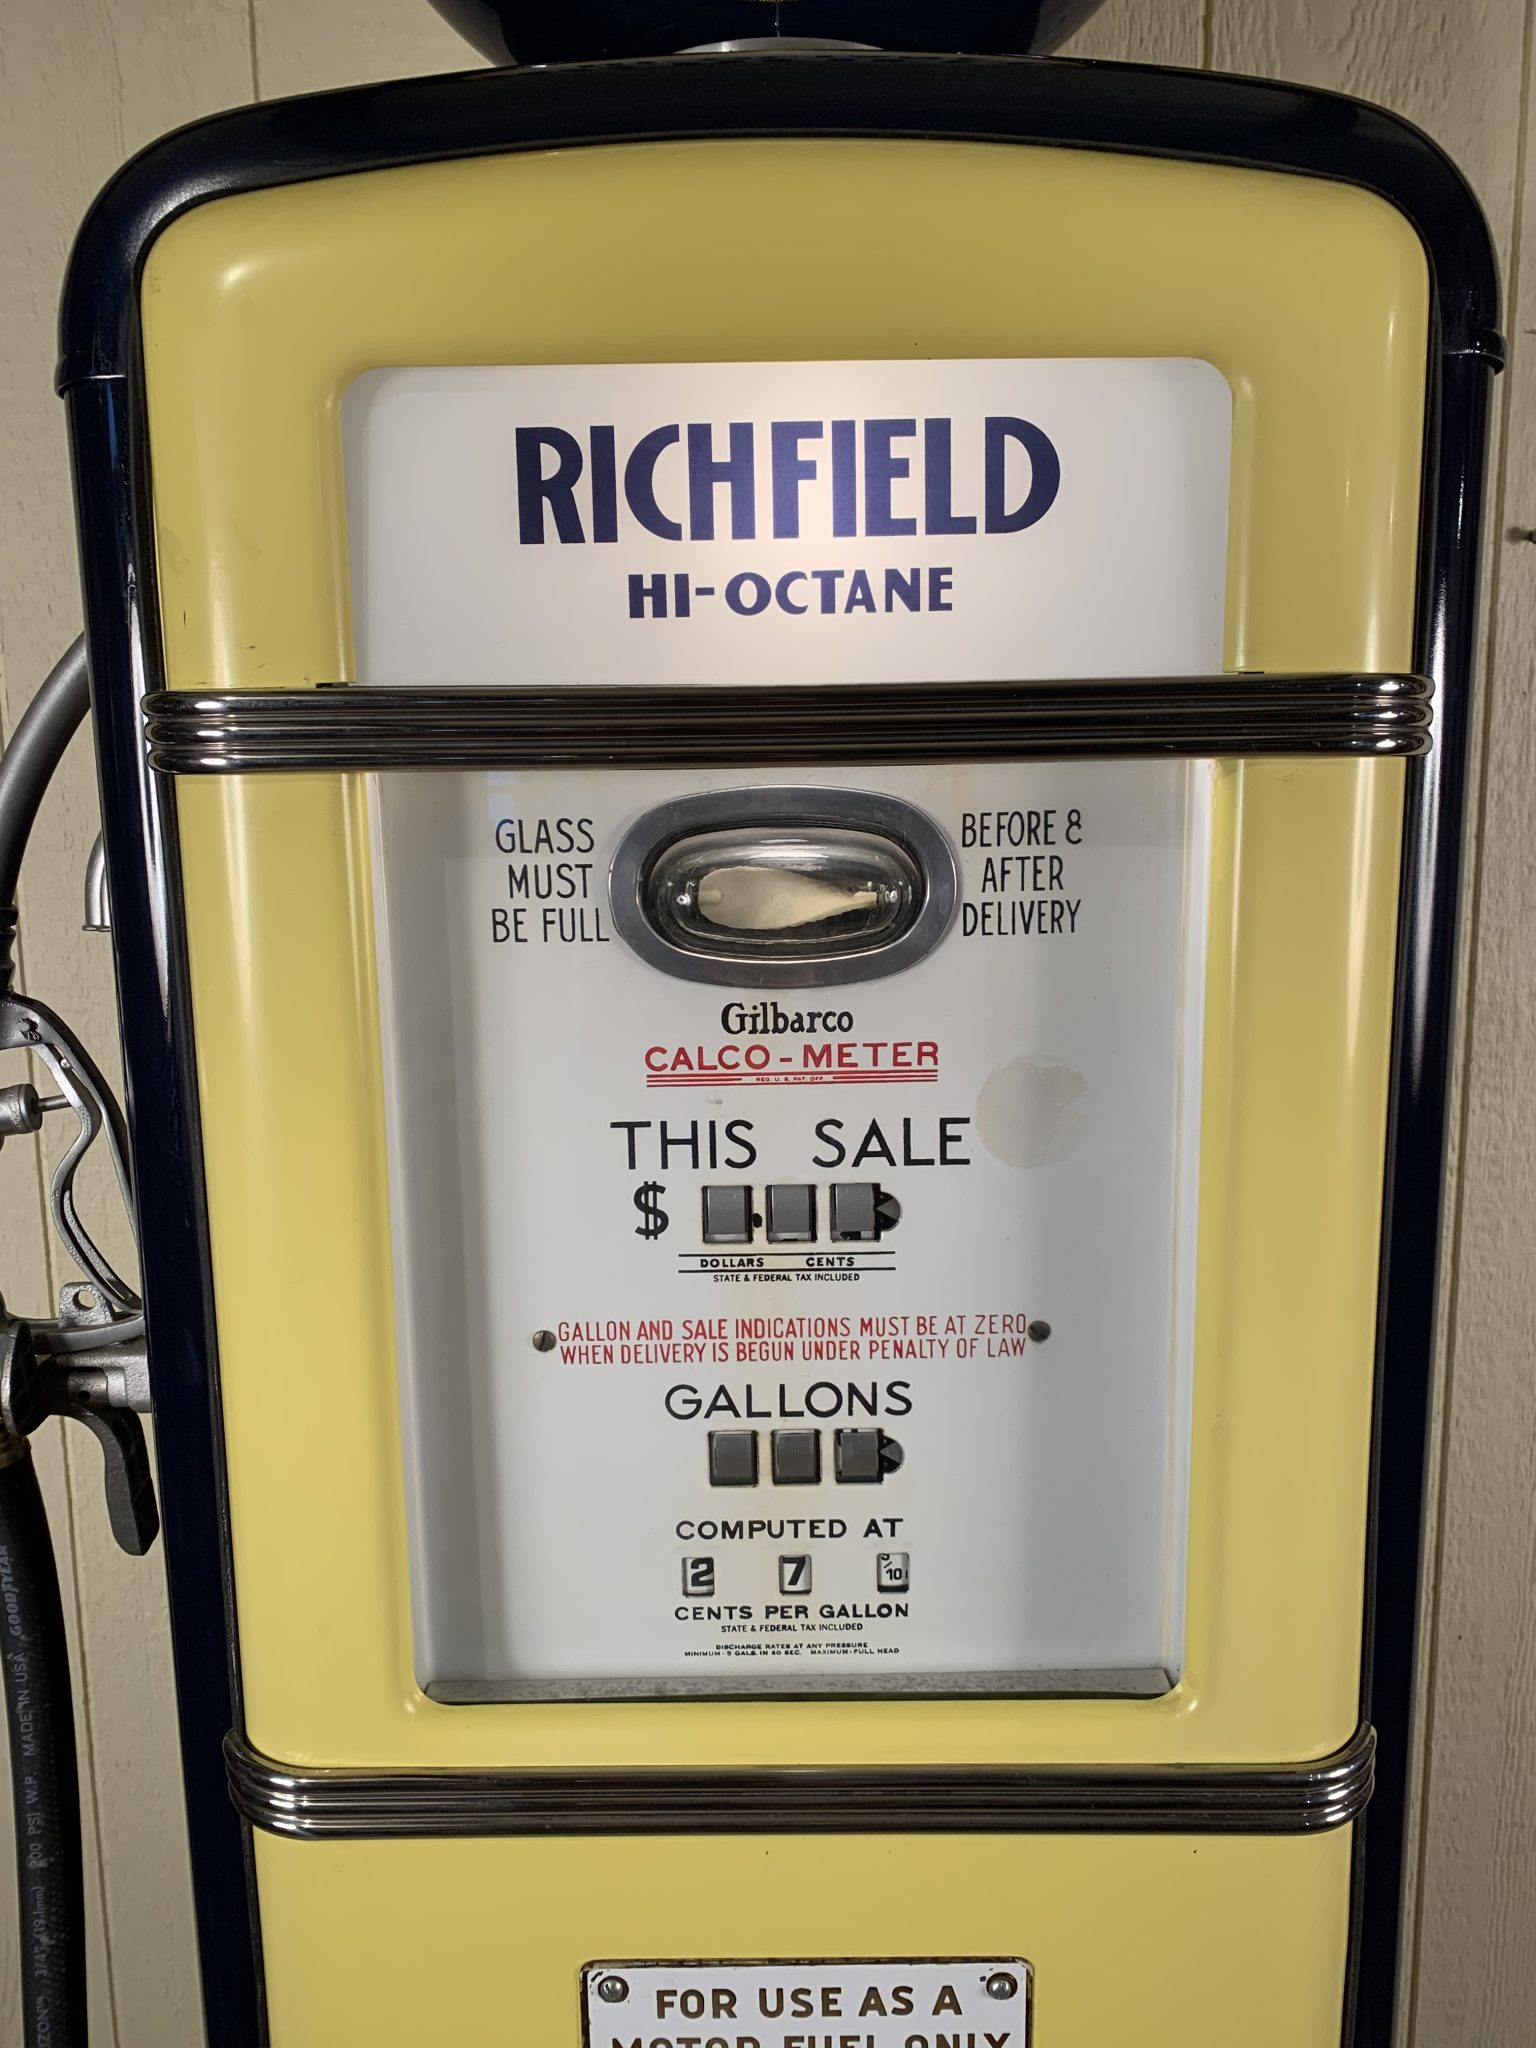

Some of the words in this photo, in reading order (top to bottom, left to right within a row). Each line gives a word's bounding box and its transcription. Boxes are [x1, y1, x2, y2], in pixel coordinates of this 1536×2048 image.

[515, 416, 1061, 545] RICHFIELD
[628, 567, 953, 619] HI-OCTANE
[495, 818, 595, 854] GLASS
[962, 809, 1057, 848] BEFORE
[508, 863, 593, 899] MUST
[981, 855, 1064, 893] AFTER
[491, 908, 528, 943] BE
[542, 907, 610, 942] FULL
[962, 899, 1082, 937] DELIVERY
[721, 1001, 854, 1035] Gilbarco
[610, 1119, 758, 1170] THIS
[812, 1117, 971, 1168] SALE
[633, 1180, 670, 1240] $
[700, 1257, 765, 1268] DOLLARS
[805, 1256, 855, 1267] CENTS
[713, 1274, 740, 1282] STATE
[743, 1274, 750, 1282] &
[753, 1274, 792, 1282] FEDERAL
[795, 1273, 812, 1281] TAX
[814, 1273, 860, 1281] INCLUDED
[558, 1320, 631, 1342] GALLON
[636, 1319, 673, 1341] AND
[682, 1319, 728, 1340] SALE
[735, 1316, 851, 1339] INDICATIONS
[859, 1316, 910, 1338] MUST
[916, 1315, 938, 1336] BE
[944, 1314, 966, 1335] AT
[974, 1313, 1026, 1334] ZERO
[560, 1344, 614, 1365] WHEN
[620, 1342, 706, 1364] DELIVERY
[712, 1342, 729, 1362] IS
[736, 1340, 794, 1362] BEGUN
[802, 1340, 861, 1361] UNDER
[869, 1338, 949, 1360] PENALTY
[956, 1338, 979, 1358] OF
[987, 1337, 1026, 1357] LAW
[664, 1380, 913, 1420] GALLONS
[675, 1518, 848, 1540] COMPUTED
[862, 1518, 904, 1538] AT
[690, 1557, 714, 1587] 2
[782, 1556, 806, 1586] 7
[0, 1545, 22, 1636] GOODYEAR
[674, 1605, 753, 1621] CENTS
[765, 1605, 809, 1619] PER
[819, 1603, 909, 1619] GALLON
[721, 1624, 748, 1633] STATE
[750, 1624, 756, 1632] &
[759, 1624, 797, 1632] FEDERAL
[800, 1623, 816, 1631] TAX
[819, 1623, 863, 1631] INCLUDED
[14, 1652, 28, 1682] USA
[16, 1689, 31, 1704] IN
[19, 1712, 35, 1757] MADE
[27, 1812, 41, 1835] PSI
[656, 1988, 738, 2019] FOR
[758, 1987, 842, 2018] USE
[858, 1985, 914, 2017] AS
[931, 1985, 963, 2016] A
